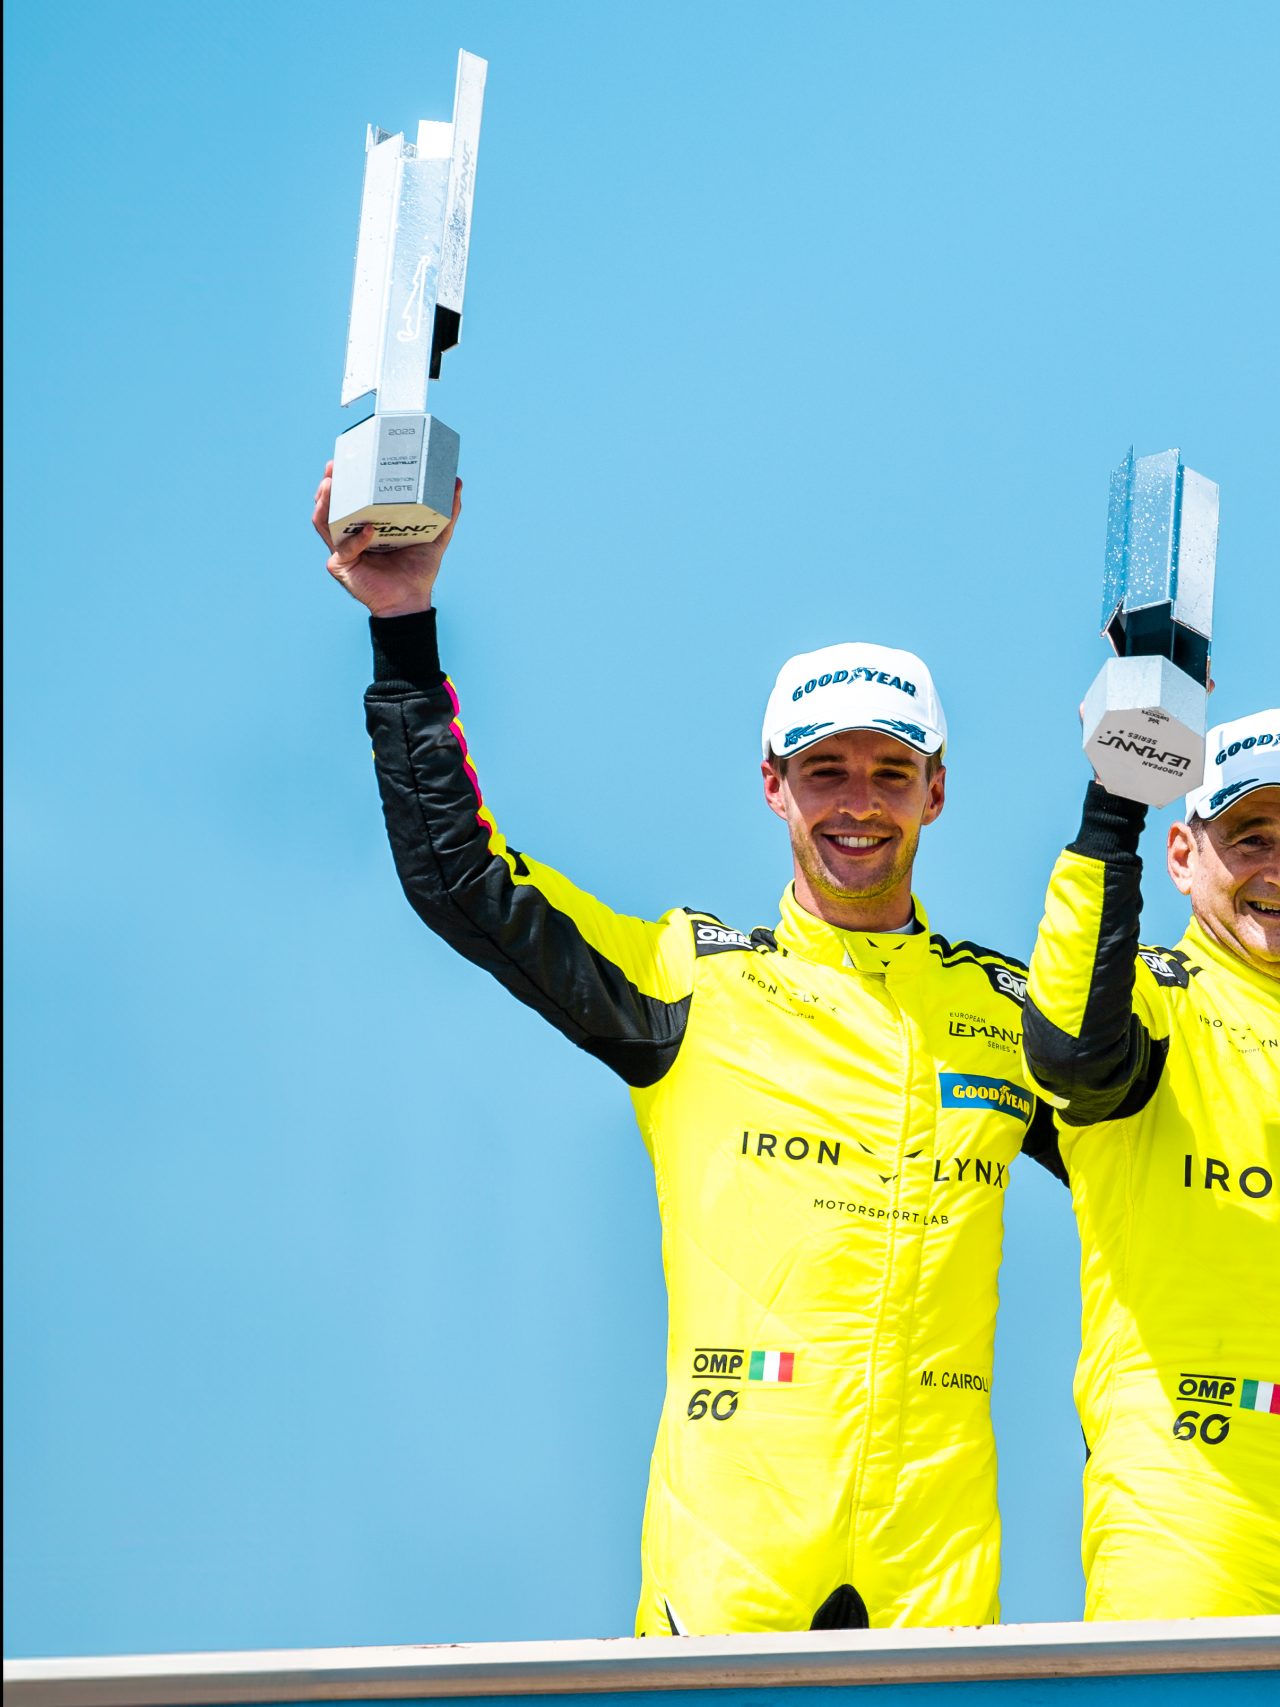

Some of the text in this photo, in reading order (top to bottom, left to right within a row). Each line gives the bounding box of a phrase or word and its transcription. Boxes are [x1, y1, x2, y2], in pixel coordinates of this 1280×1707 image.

[388, 428, 416, 436] 2023
[1127, 732, 1158, 745] SERIES
[1141, 760, 1184, 777] EUROPEAN
[741, 970, 778, 995] IRON
[949, 1012, 986, 1024] EUROPEAN
[987, 1040, 1011, 1053] SERIES
[952, 1085, 1030, 1115] GOODYEAR
[741, 1131, 1006, 1188] IRON LYNX
[813, 1198, 950, 1226] MOTORSPORT LAB
[692, 1351, 744, 1377] OMP
[920, 1370, 937, 1387] M.
[1177, 1376, 1236, 1403] OMP
[687, 1388, 739, 1421] 60
[1172, 1410, 1232, 1445] 60
